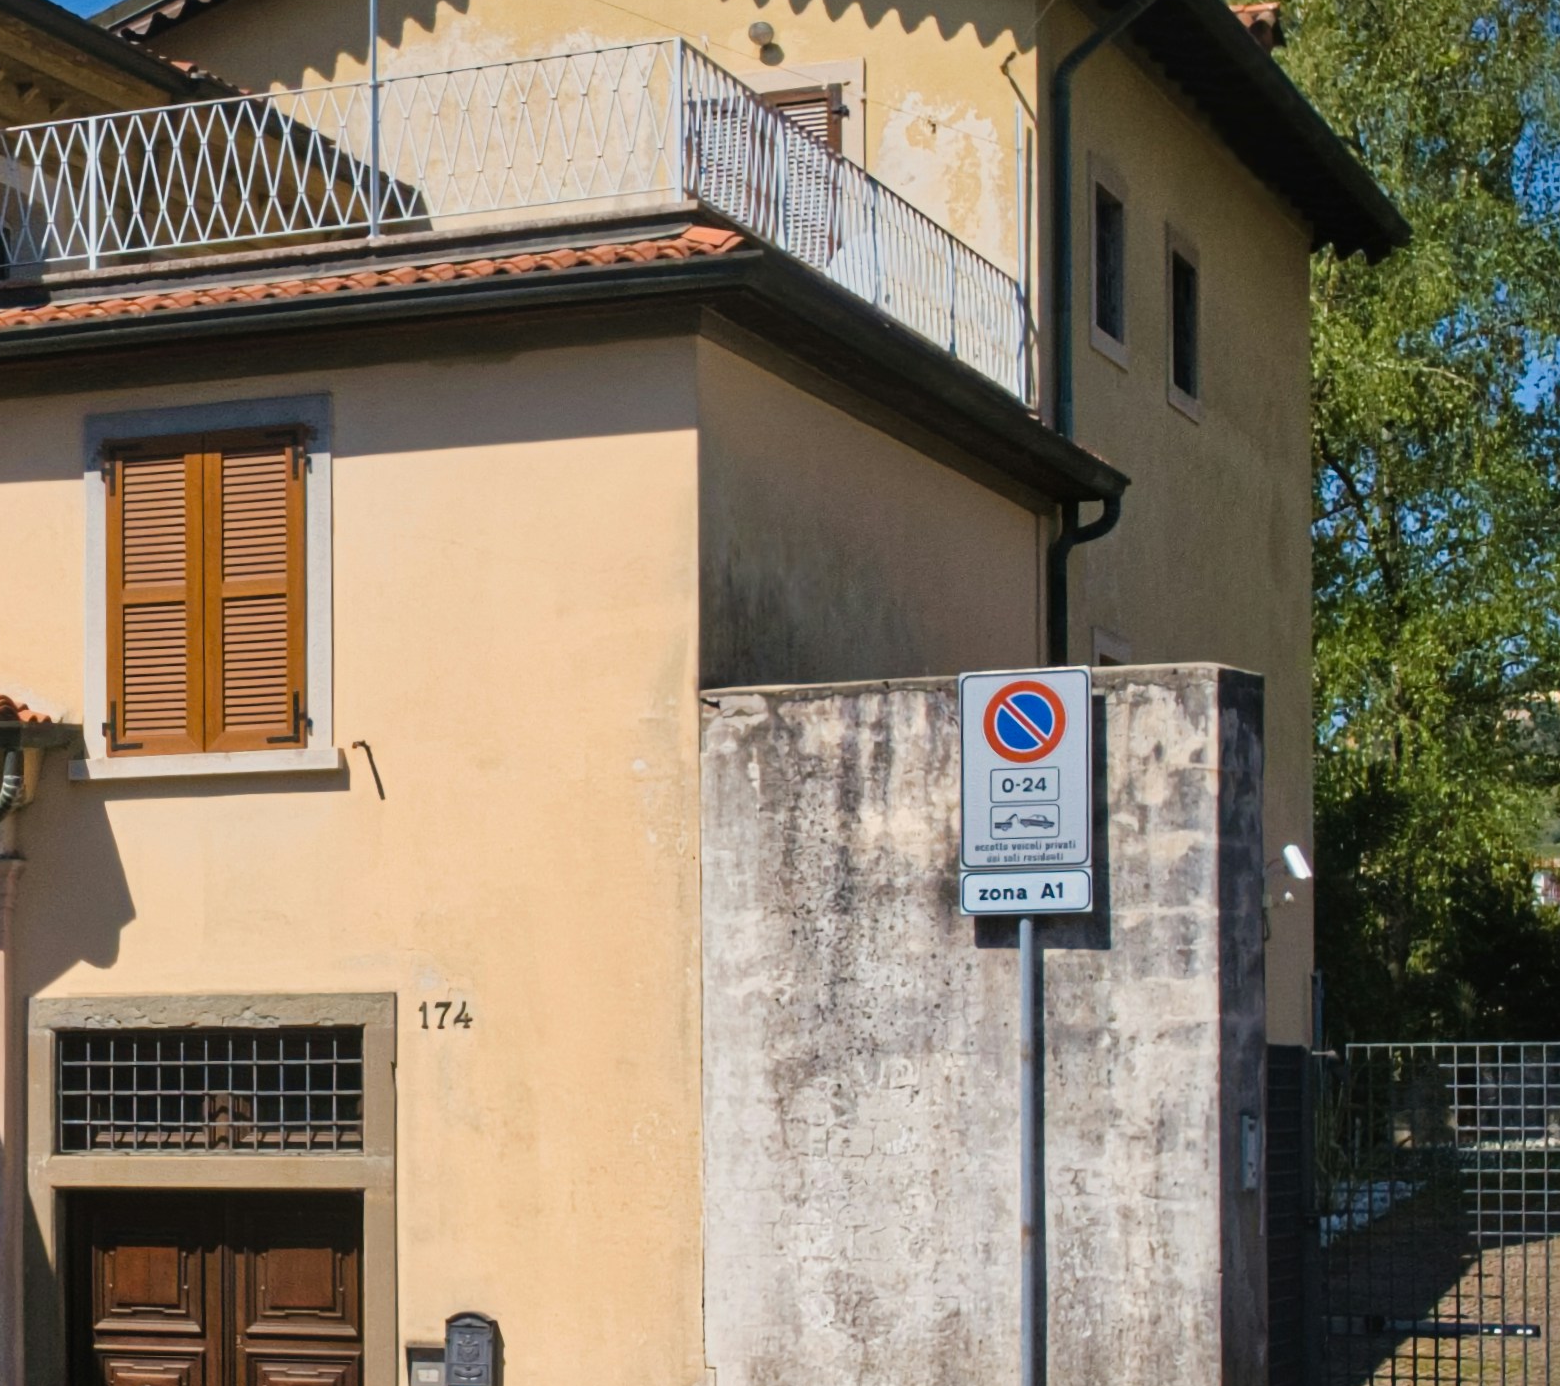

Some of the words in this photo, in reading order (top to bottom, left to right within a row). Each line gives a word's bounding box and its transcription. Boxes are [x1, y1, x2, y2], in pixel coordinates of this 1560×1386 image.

[1002, 777, 1047, 793] 0-24
[1045, 840, 1076, 852] privati
[979, 888, 1027, 901] zona
[1041, 881, 1064, 899] A1
[418, 1000, 474, 1030] 174
